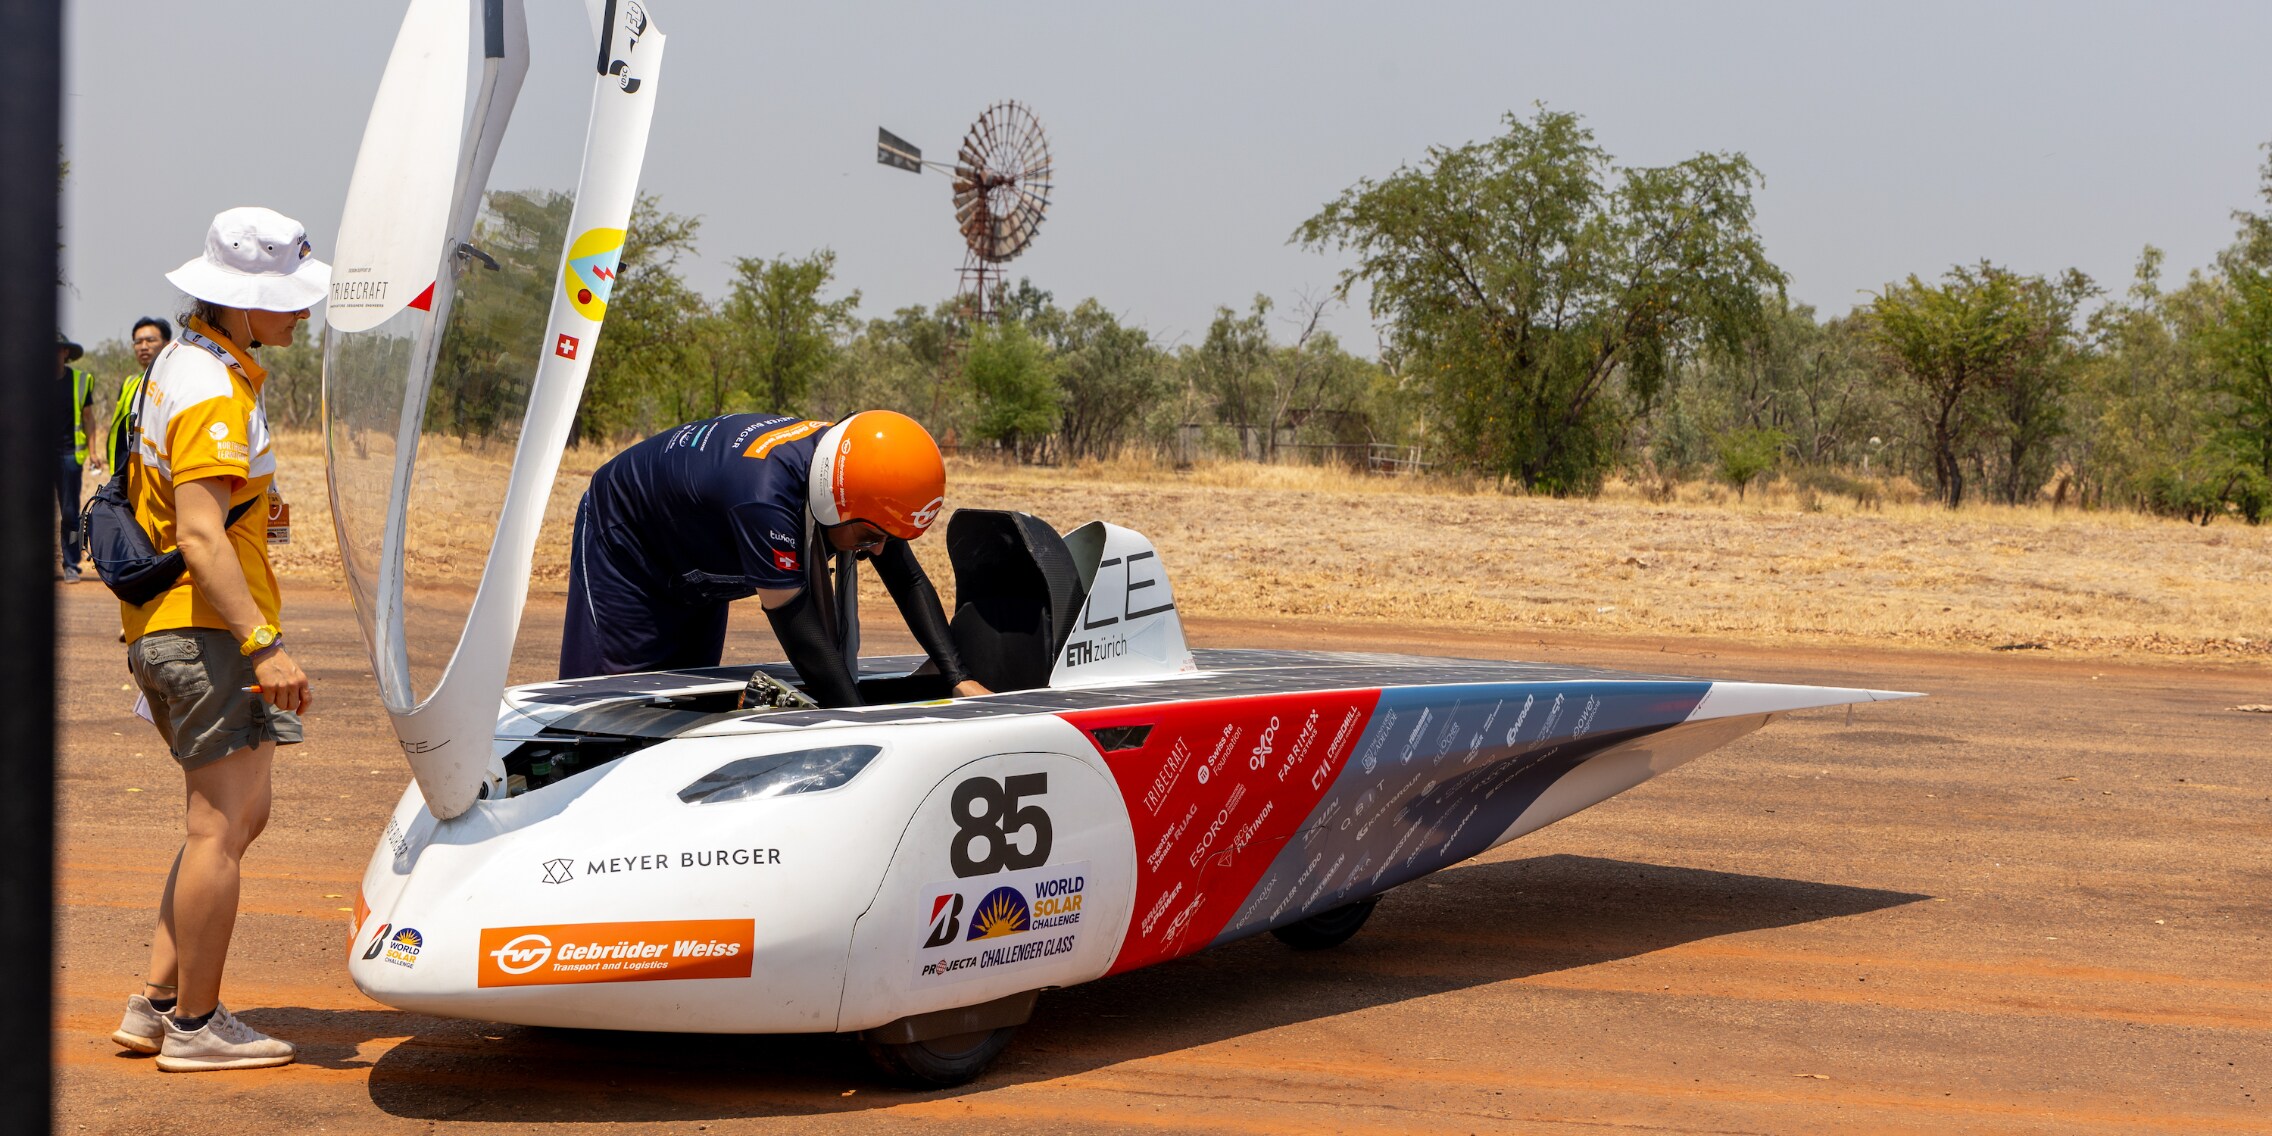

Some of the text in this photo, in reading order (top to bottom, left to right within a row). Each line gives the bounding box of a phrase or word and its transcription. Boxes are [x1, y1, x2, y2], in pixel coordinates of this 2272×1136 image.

[331, 282, 389, 300] TRIBECRAFT
[732, 422, 765, 449] BURGER
[1073, 550, 1175, 633] CE
[1066, 633, 1128, 668] ETH zürich
[1327, 705, 1358, 759] CARBOMILL
[1375, 712, 1398, 753] ADELAIDE
[1572, 694, 1595, 741] power
[1207, 723, 1234, 767] Swiss Re
[1212, 726, 1243, 776] Foundation
[1278, 709, 1319, 782] FABRIMEX
[1297, 728, 1318, 763] SYSTEMS
[1143, 736, 1188, 812] TRIBECRAFT
[950, 772, 1053, 879] 85
[1174, 803, 1198, 840] RUAG
[1189, 809, 1228, 868] ESORO
[1233, 823, 1249, 846] BCG
[1237, 800, 1274, 853] PLATINION
[587, 848, 781, 875] MEYER BURGER
[1147, 822, 1175, 865] Together
[1152, 842, 1174, 873] ahead.
[1033, 894, 1082, 918] SOLAR
[1035, 876, 1084, 899] WORLD
[1270, 852, 1322, 923] METTLER TOLEDO
[1032, 913, 1080, 931] CHALLENGE
[1141, 890, 1169, 930] BRUSA
[385, 957, 414, 969] CHALLENGE
[386, 949, 417, 963] SOLAR
[390, 941, 420, 955] WORLD
[552, 960, 669, 973] Transport and Logistics
[557, 939, 741, 961] Gebrüder Weiss
[922, 935, 1075, 976] PROJECTA CHALLENGER CLASS
